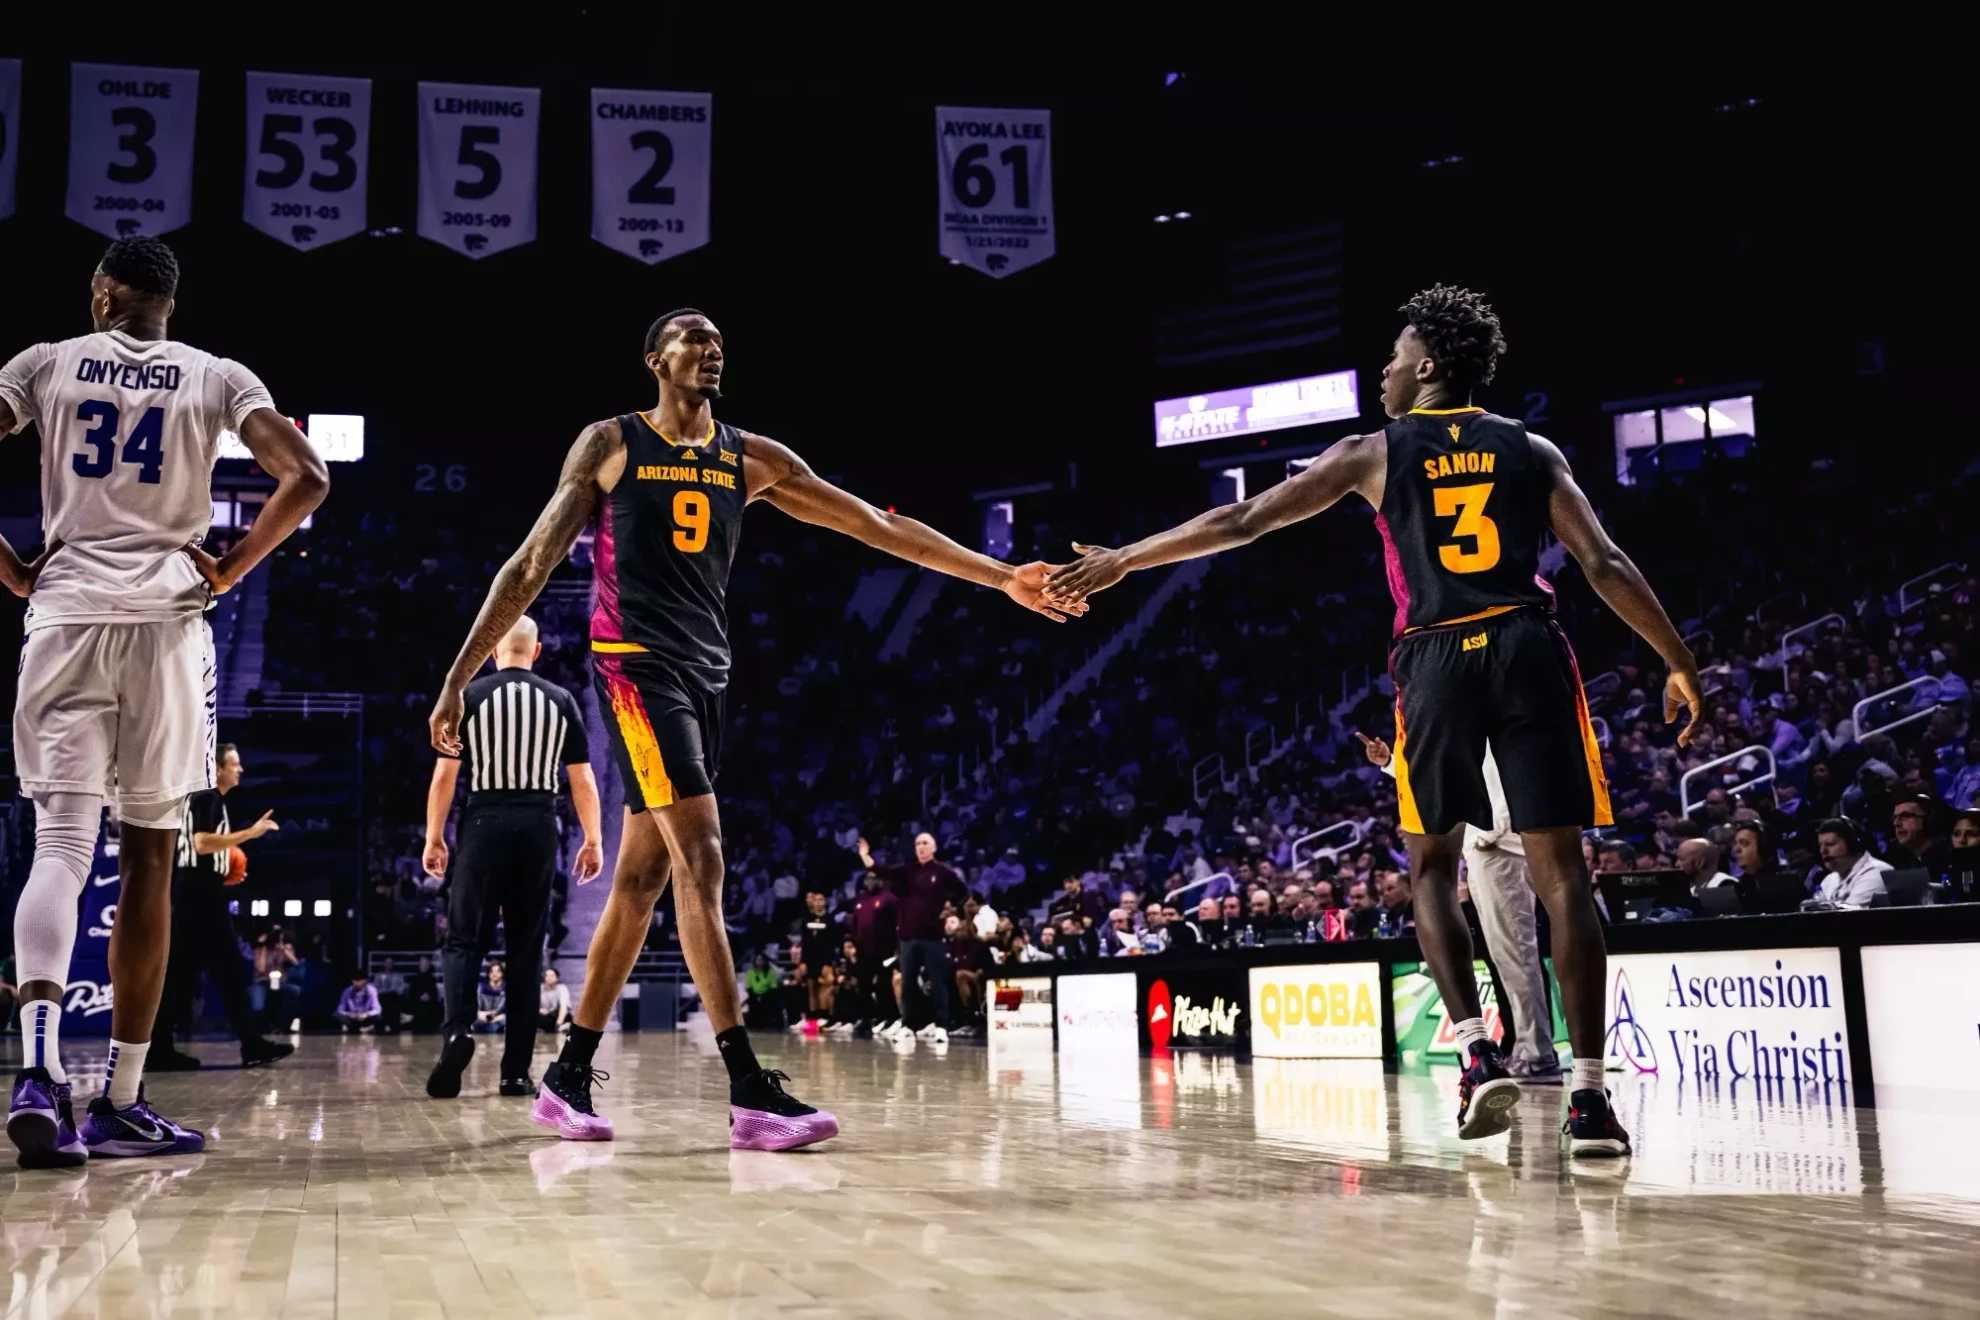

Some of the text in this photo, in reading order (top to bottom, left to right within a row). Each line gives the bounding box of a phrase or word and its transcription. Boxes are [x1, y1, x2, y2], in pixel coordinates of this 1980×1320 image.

[99, 80, 171, 99] OHLDE
[266, 87, 352, 108] WECKER
[434, 98, 524, 118] LEHNING
[597, 103, 706, 123] CHAMBERS
[107, 107, 156, 184] 3
[943, 121, 1046, 139] AYOKA LEE
[255, 114, 357, 192] 53
[454, 125, 502, 200] 5
[628, 130, 675, 205] 2
[953, 143, 1029, 209] 61
[94, 196, 165, 212] 2000-04
[270, 202, 340, 220] 2001-05
[442, 211, 511, 228] 2005-09
[618, 217, 684, 233] 2009-13
[76, 358, 180, 391] ONYENSO
[1524, 391, 1549, 424] 2
[72, 399, 164, 484] 34
[414, 463, 468, 493] 26
[637, 465, 737, 490] ARIZONA STATE
[1424, 452, 1496, 480] SANON
[673, 490, 710, 553] 9
[1433, 482, 1500, 574] 3
[1463, 632, 1488, 652] ASU
[1666, 960, 1831, 1008] Ascension
[1173, 995, 1210, 1036] Pizza
[1210, 996, 1240, 1036] Hut
[1260, 982, 1377, 1040] QDOBA
[1668, 1029, 1847, 1083] Via Christi
